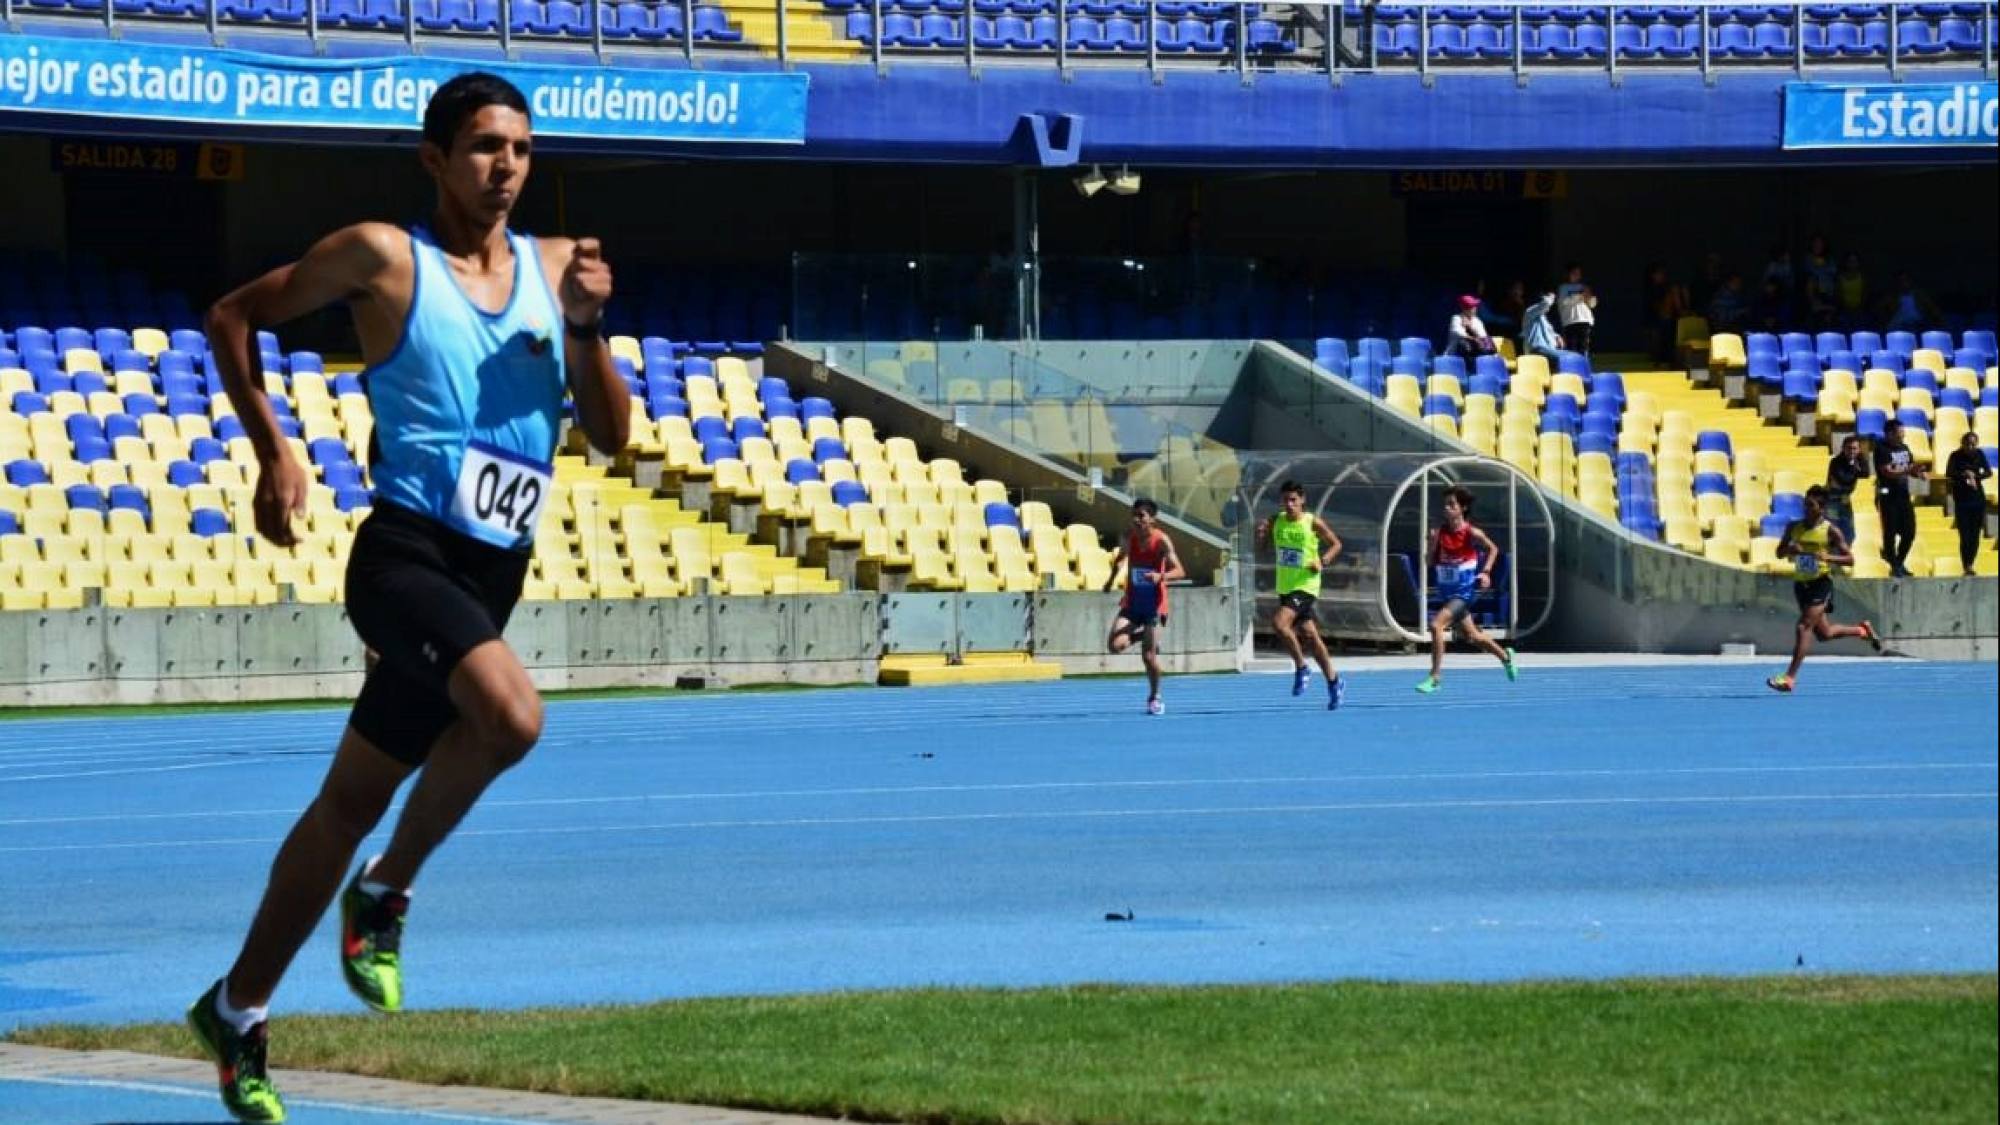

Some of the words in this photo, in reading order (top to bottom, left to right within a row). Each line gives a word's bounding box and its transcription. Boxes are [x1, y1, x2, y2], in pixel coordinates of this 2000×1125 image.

[0, 46, 80, 103] ejor
[87, 55, 228, 104] estadio
[236, 72, 321, 116] para
[330, 68, 363, 109] el
[532, 76, 739, 124] cuidémoslo!
[62, 143, 145, 168] SALIDA
[1400, 172, 1476, 193] SALIDA
[475, 462, 540, 534] 042
